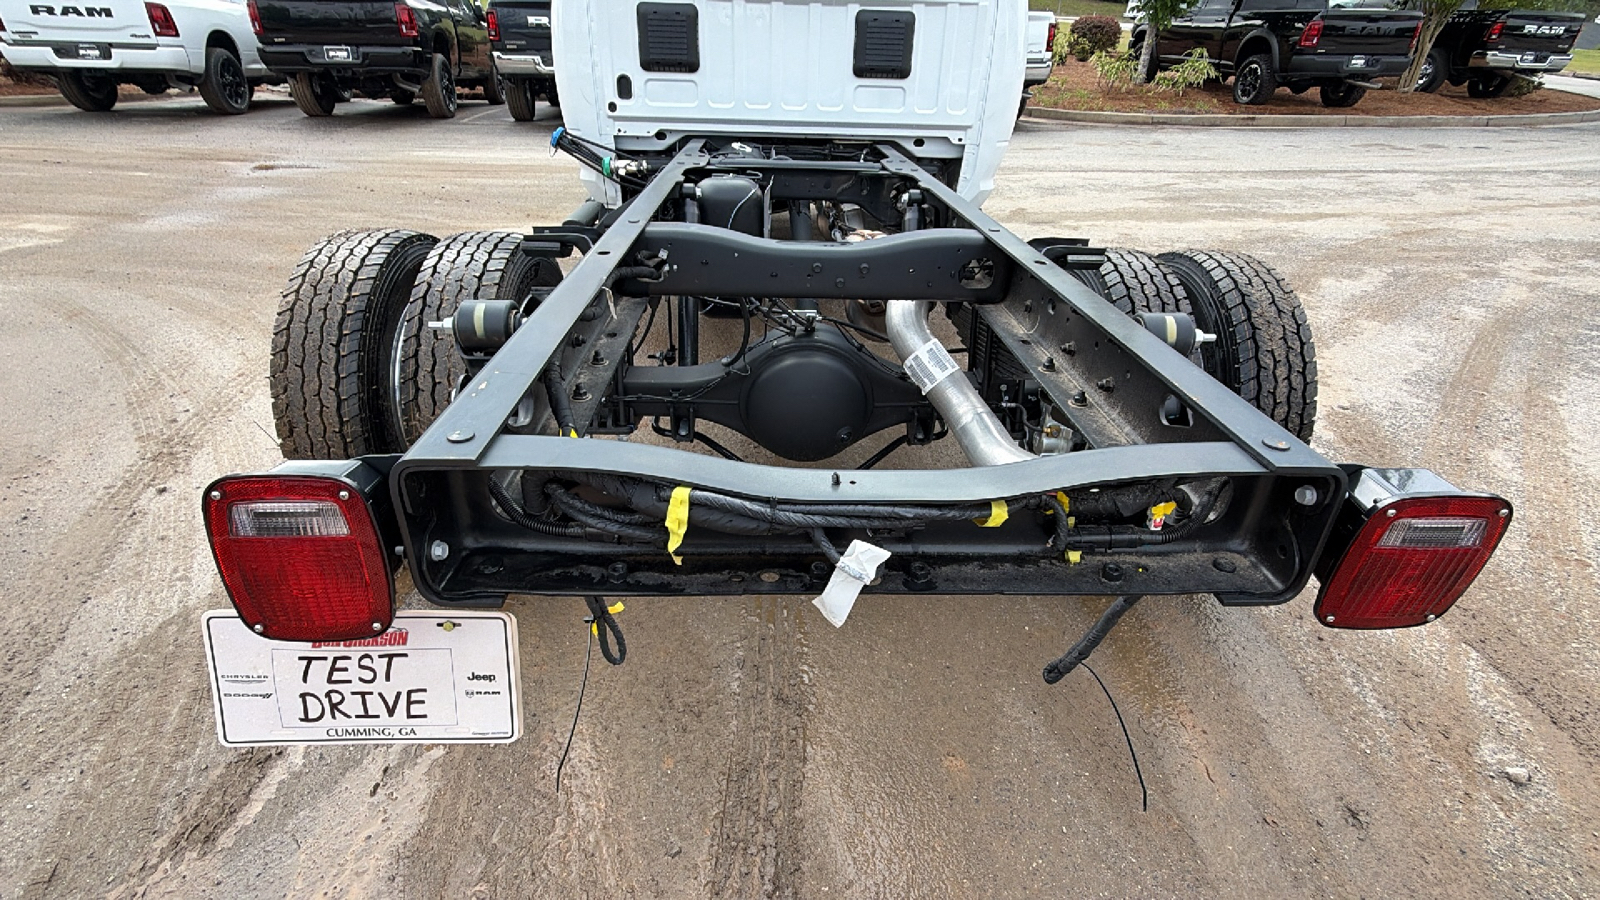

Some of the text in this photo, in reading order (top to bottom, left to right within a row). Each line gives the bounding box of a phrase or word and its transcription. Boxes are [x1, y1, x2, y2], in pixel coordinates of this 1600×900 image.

[29, 5, 114, 18] RAM
[1344, 26, 1396, 36] RAM
[1522, 24, 1566, 35] RAM
[298, 653, 409, 684] TEST
[467, 671, 496, 683] Jeep
[298, 688, 428, 723] DRIVE
[326, 727, 417, 738] CUMMING, GA
